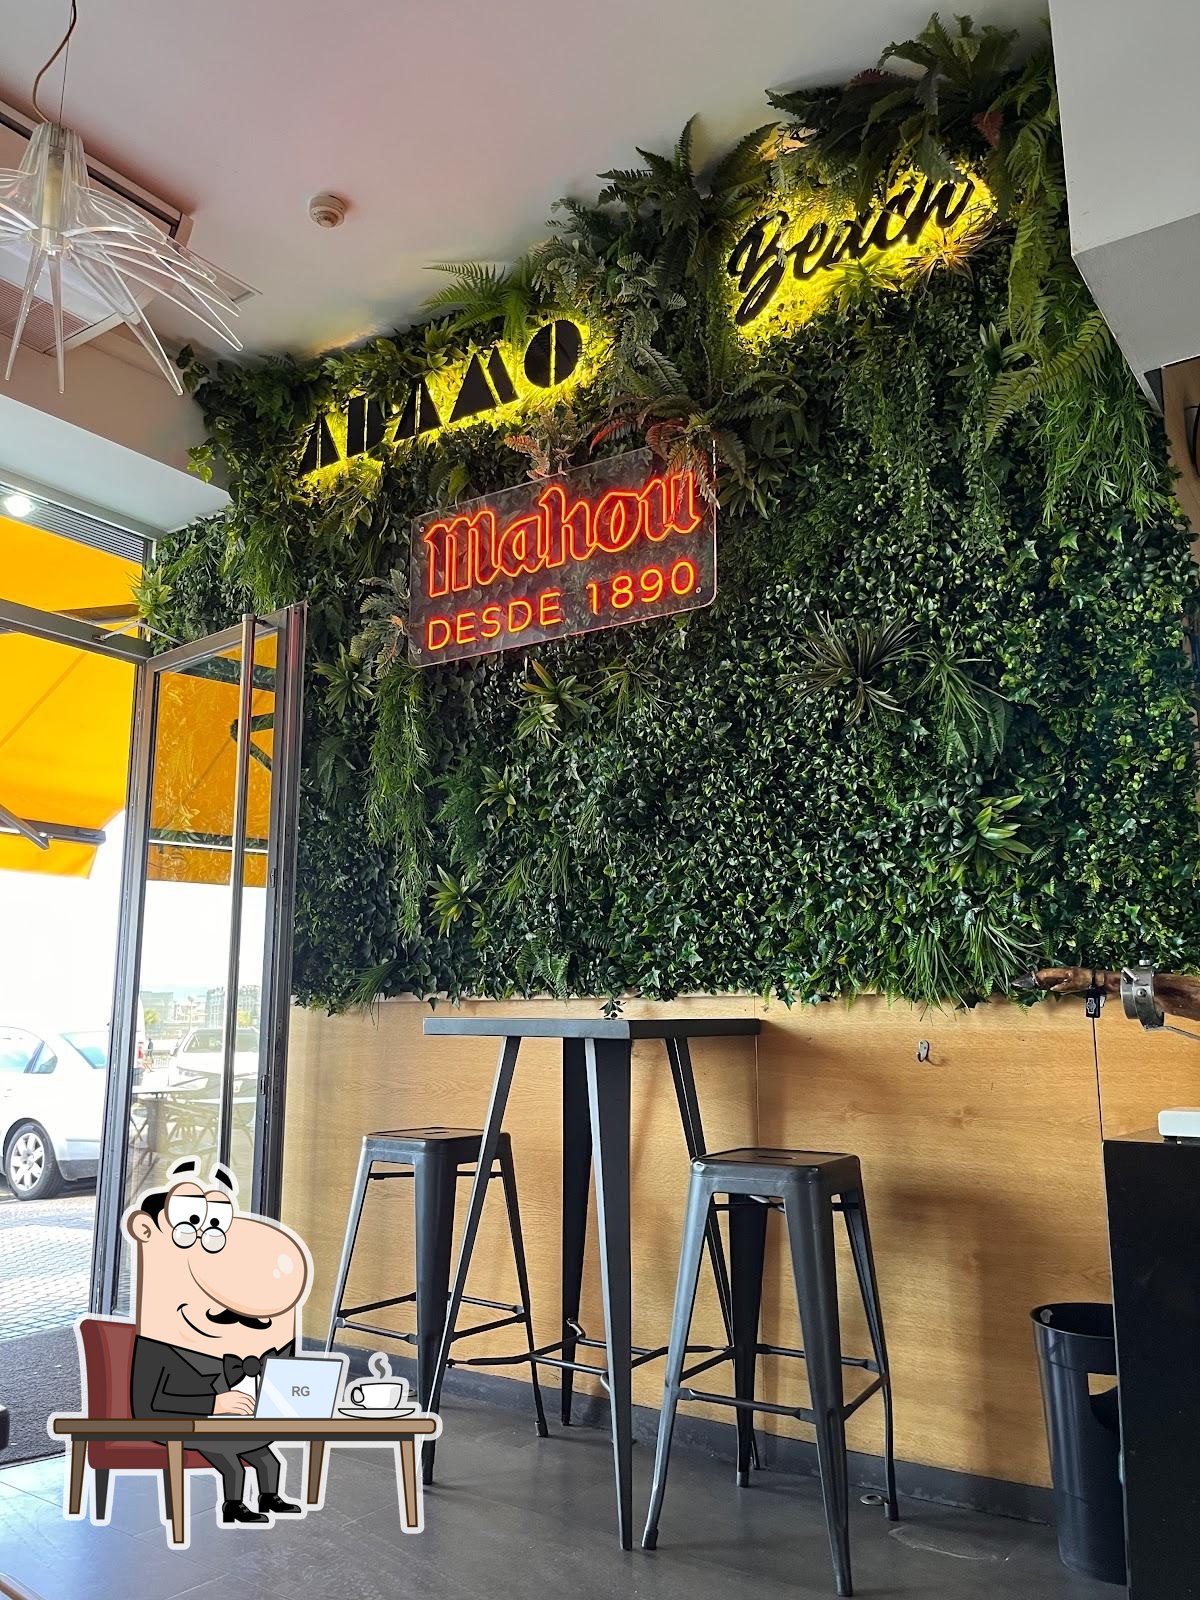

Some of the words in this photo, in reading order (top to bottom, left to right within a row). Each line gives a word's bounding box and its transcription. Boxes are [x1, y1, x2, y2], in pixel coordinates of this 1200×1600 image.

[727, 172, 976, 326] Beach
[423, 471, 702, 598] Mahou
[427, 591, 561, 650] DESDE
[586, 561, 695, 616] 1890
